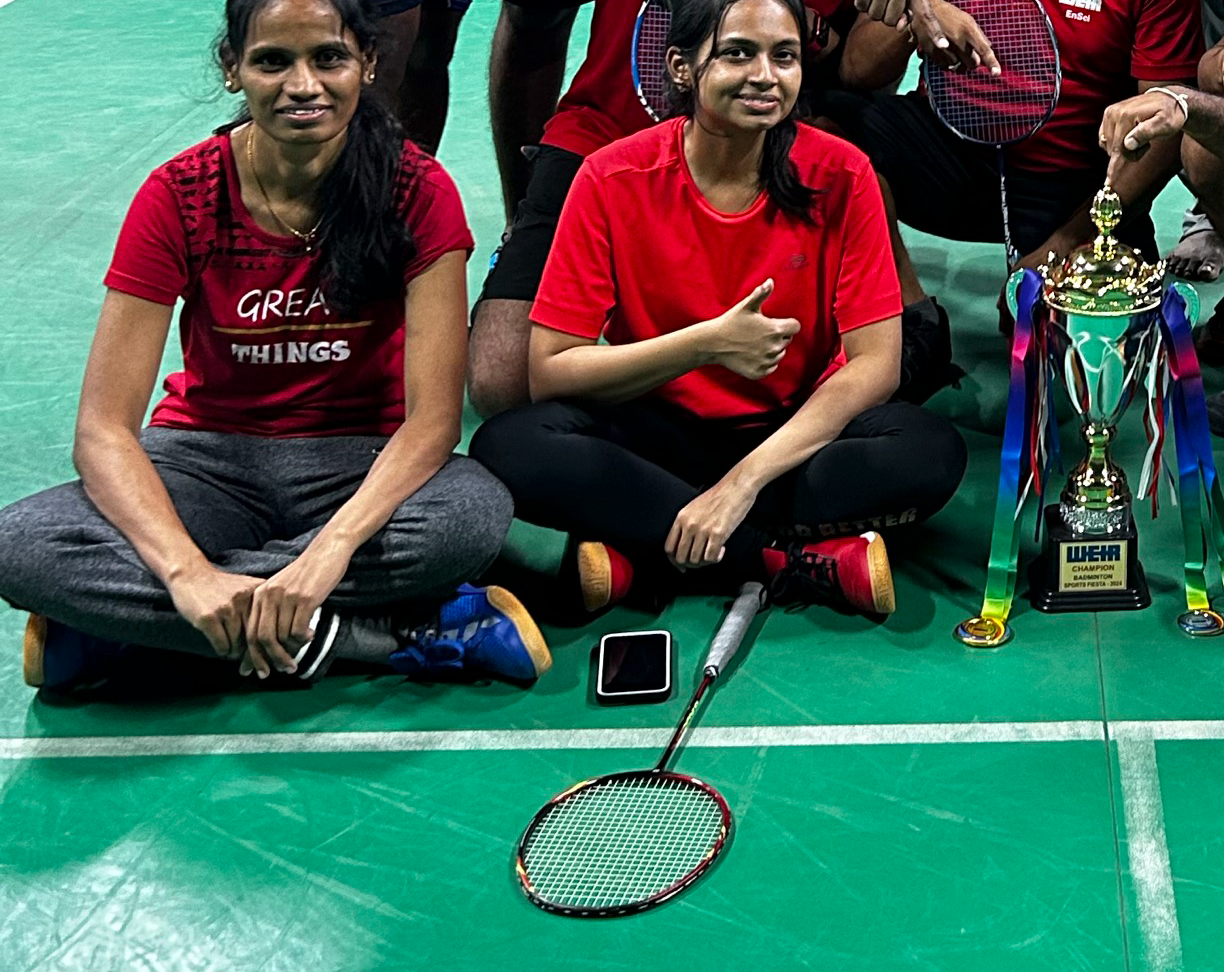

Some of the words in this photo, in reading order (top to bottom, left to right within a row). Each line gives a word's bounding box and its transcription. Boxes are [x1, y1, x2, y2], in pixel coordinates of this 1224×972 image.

[236, 287, 331, 322] GREA
[231, 340, 351, 364] THINGS
[1066, 544, 1121, 563] WEIR
[1071, 564, 1115, 572] CHAMPION
